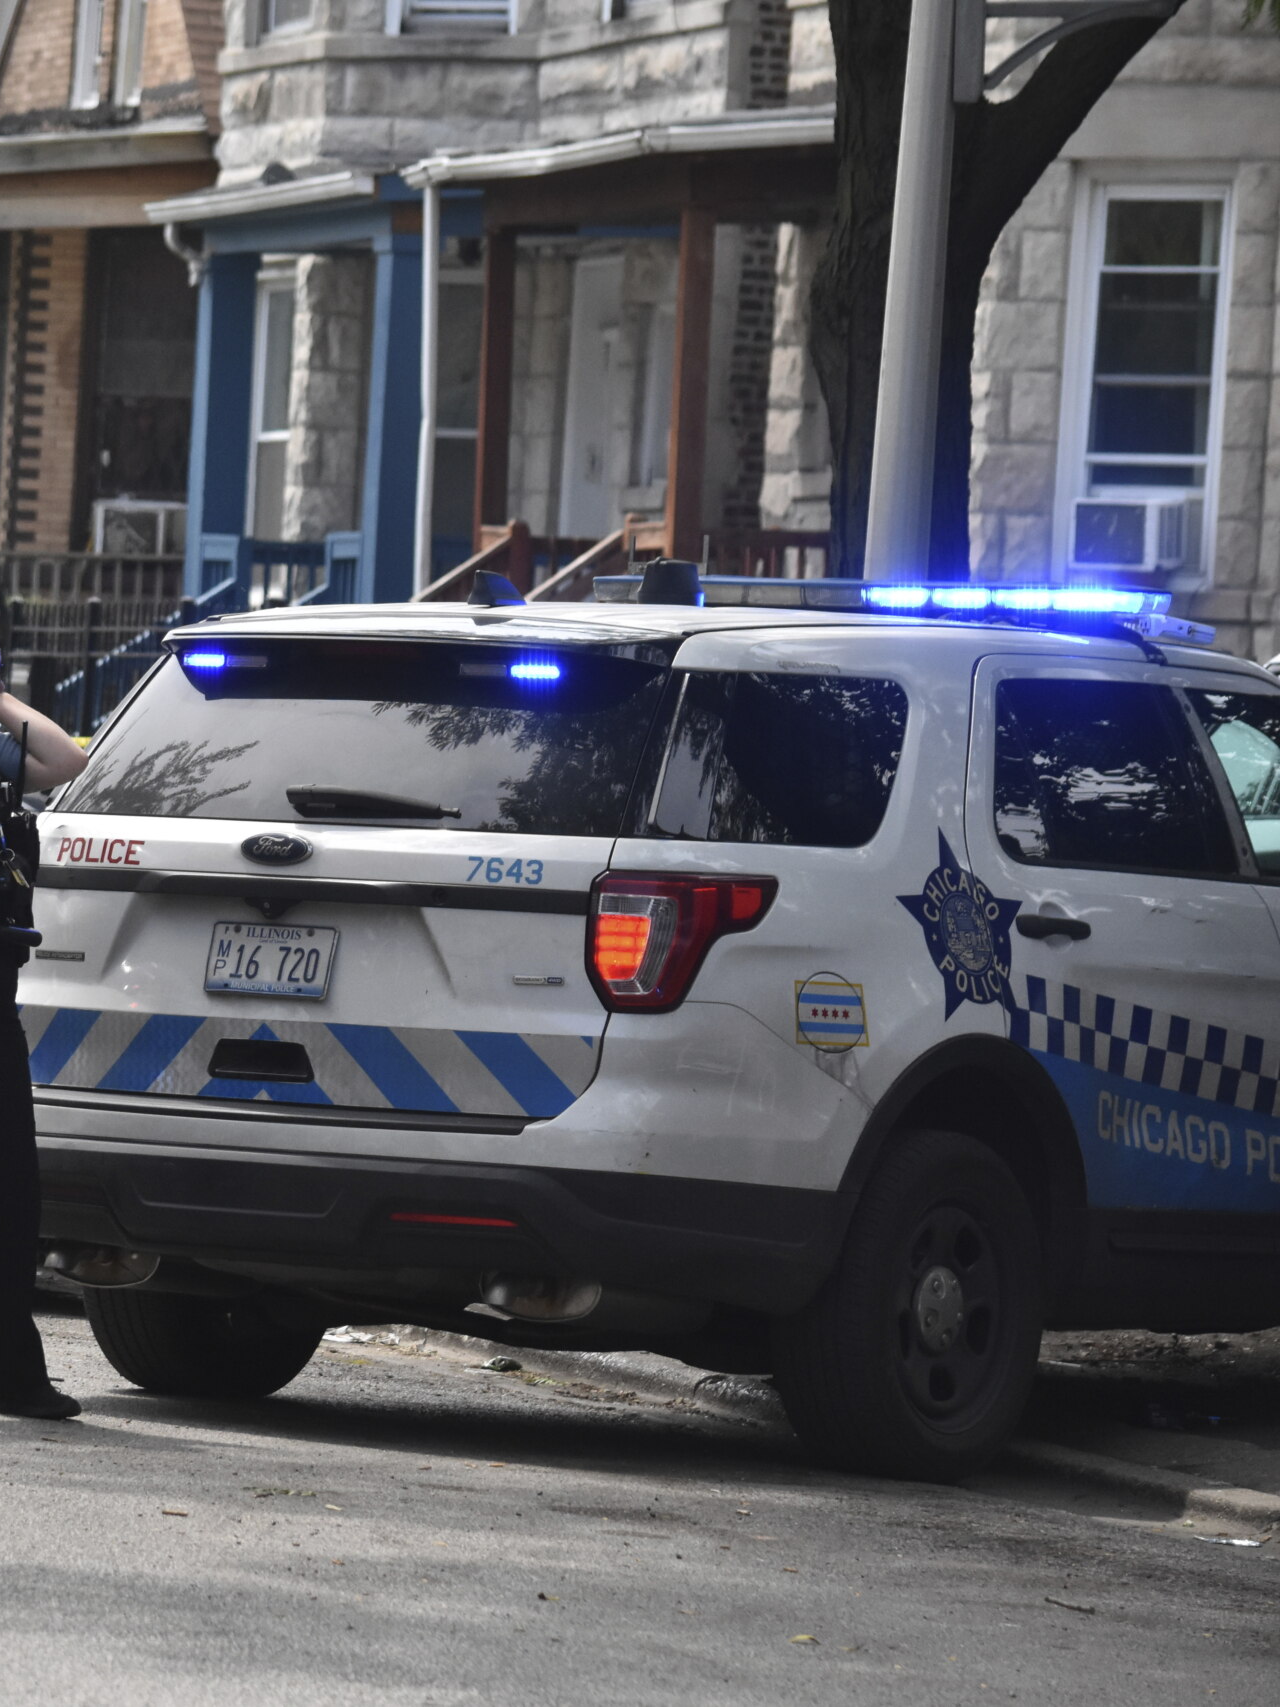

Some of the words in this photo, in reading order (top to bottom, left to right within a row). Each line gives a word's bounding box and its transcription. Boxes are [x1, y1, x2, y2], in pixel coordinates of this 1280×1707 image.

[56, 837, 145, 865] POLICE
[253, 835, 294, 856] Ford
[466, 856, 544, 885] 7643
[923, 868, 1000, 922] CHICAGO
[246, 926, 303, 940] ILLINOIS
[228, 944, 262, 979] 16
[277, 946, 321, 983] 720
[939, 954, 1009, 1001] POLICE
[230, 981, 270, 991] MUNICIPAL
[271, 983, 296, 993] POLICE
[1098, 1090, 1232, 1170] CHICAGO
